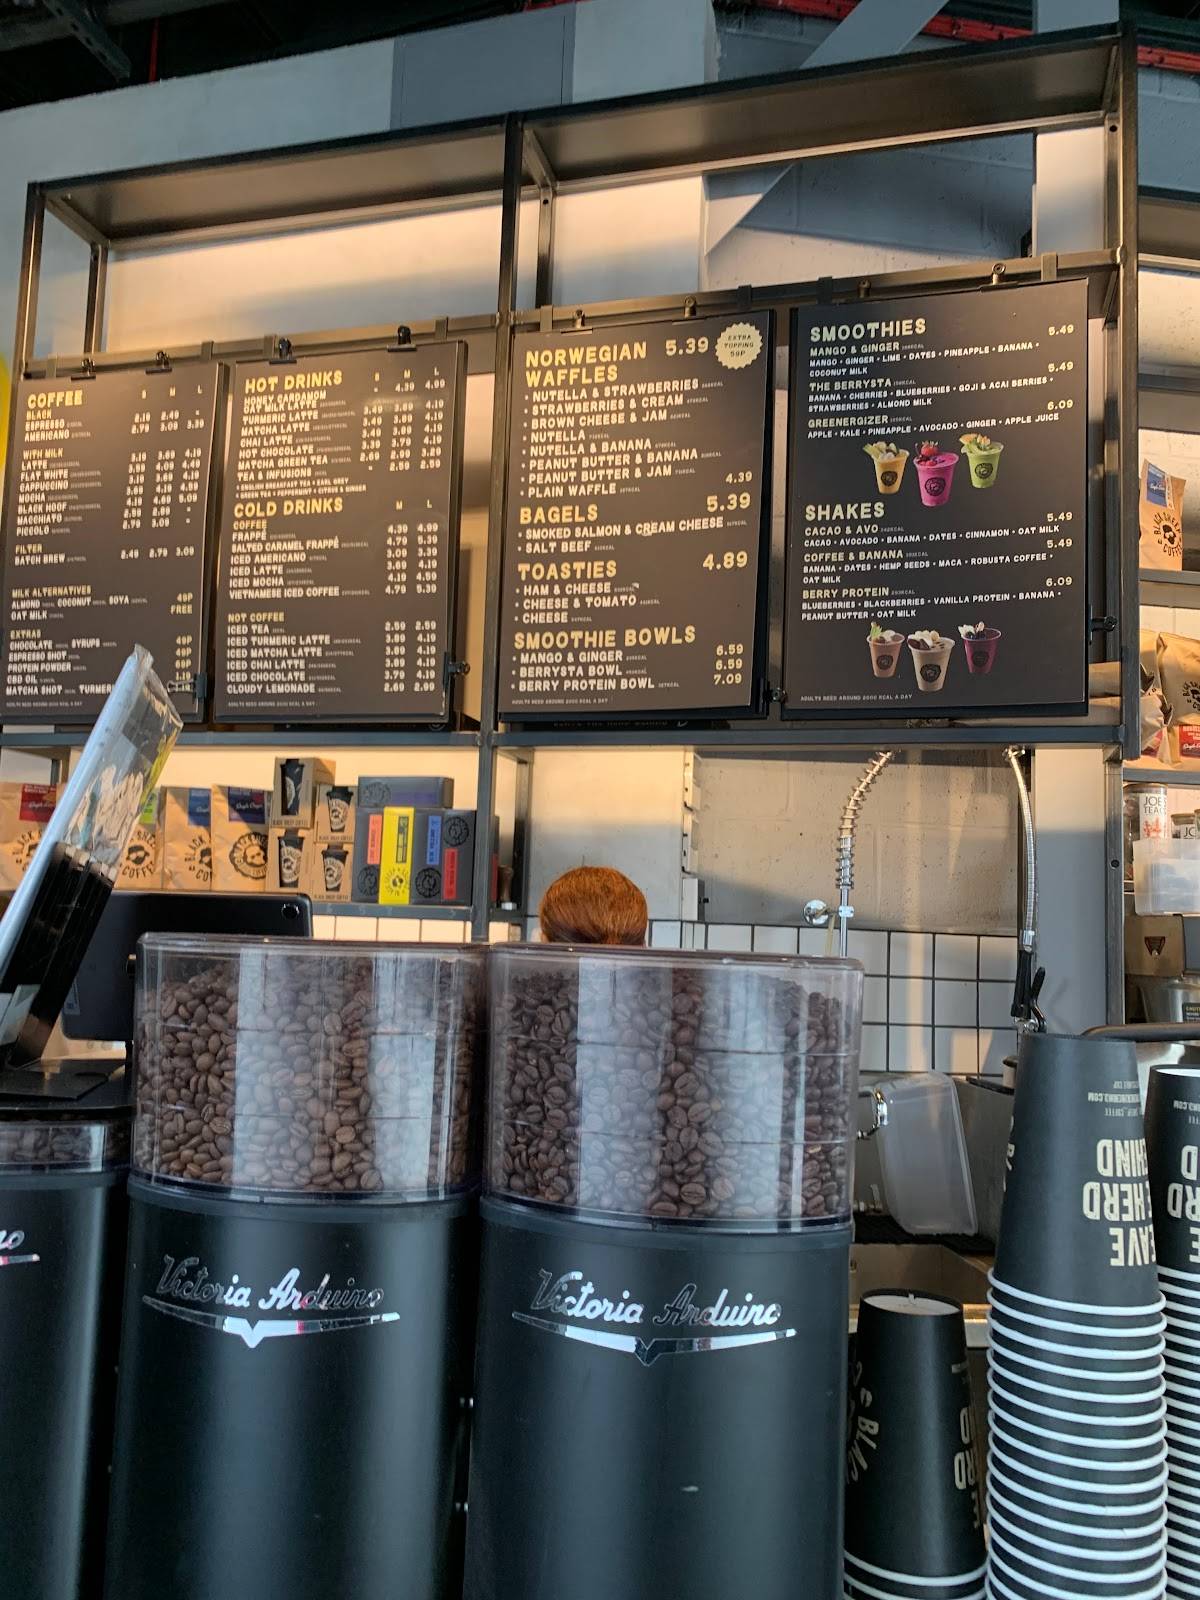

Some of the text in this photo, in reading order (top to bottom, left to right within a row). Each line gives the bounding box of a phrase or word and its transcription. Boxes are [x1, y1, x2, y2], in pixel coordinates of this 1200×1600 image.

[810, 318, 926, 342] SMOOTHIES
[1049, 324, 1074, 336] 5.49
[666, 337, 708, 356] 5.39
[810, 345, 846, 356] MANGO
[851, 345, 856, 354] &
[861, 342, 899, 353] GINGER
[526, 342, 647, 367] NORWEGIAN
[810, 342, 1032, 366] MANGO GINGER LIME DATES PINEAPPLE BANANA
[810, 367, 867, 377] COCONUT MILK
[1048, 362, 1073, 372] 5.49
[246, 370, 342, 393] HOT DRINKS
[526, 365, 618, 387] WAFFLES
[533, 389, 587, 401] NUTELLA
[593, 388, 598, 398] &
[604, 379, 698, 396] STRAWBERRIES
[810, 379, 891, 392] THE BERRYSTA
[28, 390, 83, 408] COFFEE
[532, 401, 624, 415] STRAWBERRIES
[630, 400, 636, 408] &
[642, 395, 683, 408] CREAM
[1048, 400, 1073, 410] 6.09
[243, 411, 318, 425] TURMERIC LATTE
[532, 410, 667, 429] BROWN CHEESE & JAM
[808, 415, 888, 428] GREENERGIZER
[242, 423, 310, 436] MATCHA LATTE
[808, 413, 1058, 439] APPLE KALE PINEAPPLE AVOCADO GINGER APPLE JUICE
[240, 436, 293, 448] CHAI LATTE
[531, 430, 585, 443] NUTELLA
[239, 445, 314, 459] HOT CHOCOLATE
[530, 439, 651, 457] NUTELLA & BANANA
[22, 460, 47, 470] LATTE
[238, 455, 328, 471] MATCHA GREEN TEA
[530, 449, 698, 471] PEANUT BUTTER & BANANA
[21, 469, 68, 481] FLAT WHITE
[529, 465, 672, 484] PEANUT BUTTER & JAM
[726, 471, 752, 483] 4.39
[20, 480, 68, 492] CAPPUCCINO
[528, 483, 616, 498] PLAIN WAFFLE
[234, 497, 343, 518] COLD DRINKS
[707, 493, 750, 512] 5.39
[520, 504, 598, 524] BAGELS
[806, 502, 884, 521] SHAKES
[1047, 512, 1072, 522] 5.49
[233, 519, 267, 530] COFFEE
[526, 517, 723, 540] SMOKED SALMON & CREAM CHEESE
[805, 524, 878, 536] CACAO & AVO
[526, 541, 591, 553] SALT BEEF
[1047, 538, 1072, 548] 5.49
[231, 552, 306, 565] ICED AMERICANO
[703, 551, 747, 570] 4.89
[804, 550, 903, 562] COFFEE & BANANA
[518, 560, 617, 580] TOASTIES
[1046, 576, 1072, 587] 6.09
[524, 583, 611, 596] HAM & CHEESE
[802, 587, 889, 599] BERRY PROTEIN
[523, 596, 636, 609] CHEESE & TOMATO
[802, 590, 1054, 610] BLUEBERRIES BLACKBERRIES VANILLA PROTEIN BANANA
[11, 610, 47, 620] OAT MILK
[171, 604, 192, 614] FREE
[228, 612, 284, 623] NOT COFFEE
[523, 612, 568, 623] CHEESE
[228, 624, 269, 635] ICED TEA
[514, 626, 695, 649] SMOOTHIE BOWLS
[716, 644, 743, 655] 6.59
[521, 651, 623, 664] MANGO & GINGER
[8, 662, 71, 672] PROTEIN POWDER
[520, 665, 622, 677] BERRYSTA BOWL
[716, 660, 742, 670] 6.59
[519, 678, 654, 692] BERRY PROTEIN BOWL
[714, 674, 742, 685] 7.09
[227, 683, 315, 694] CLOUDY LEMONADE
[154, 1254, 384, 1310] Victoria Arduino
[530, 1268, 781, 1326] Victoria Arduino
